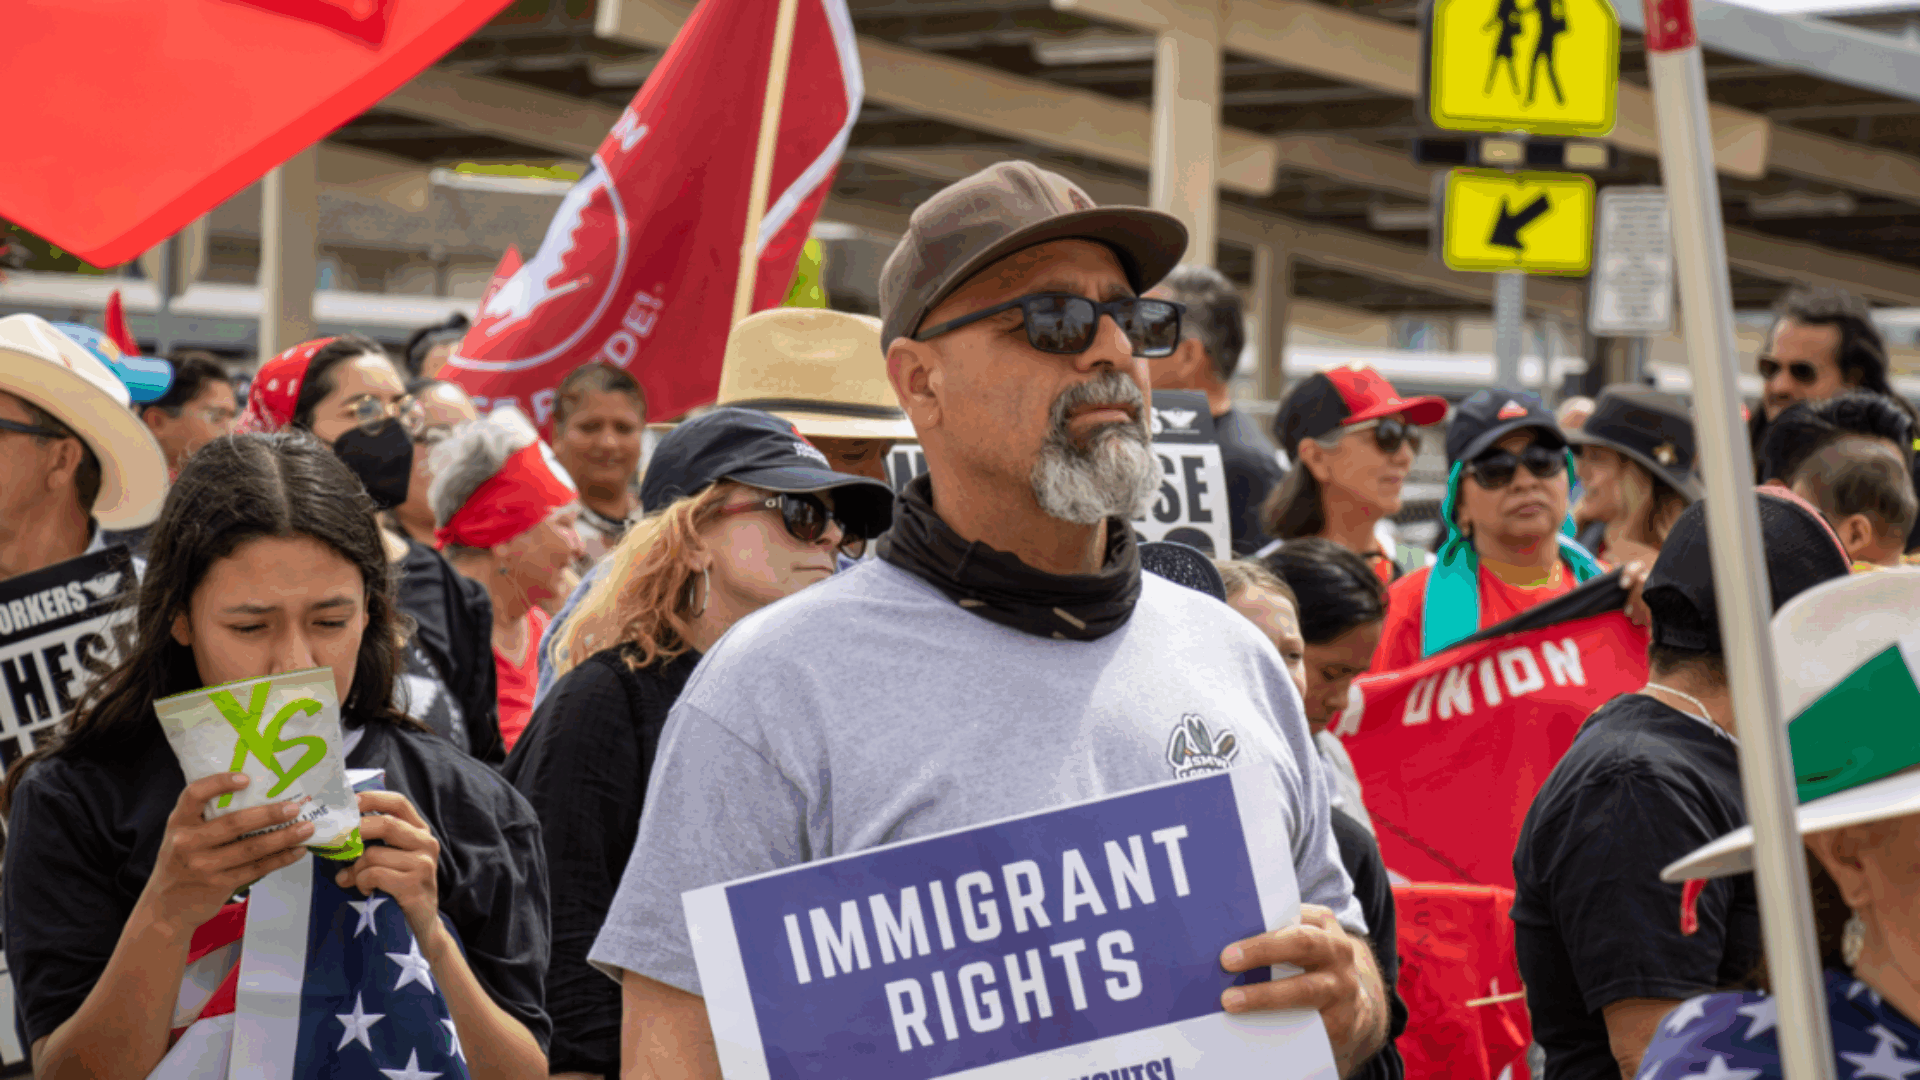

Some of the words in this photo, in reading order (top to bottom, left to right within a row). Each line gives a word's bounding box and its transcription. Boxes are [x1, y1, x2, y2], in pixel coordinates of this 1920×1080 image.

[1402, 638, 1587, 726] UNION
[783, 825, 1191, 985] IMMIGRANT
[884, 929, 1143, 1052] RIGHTS
